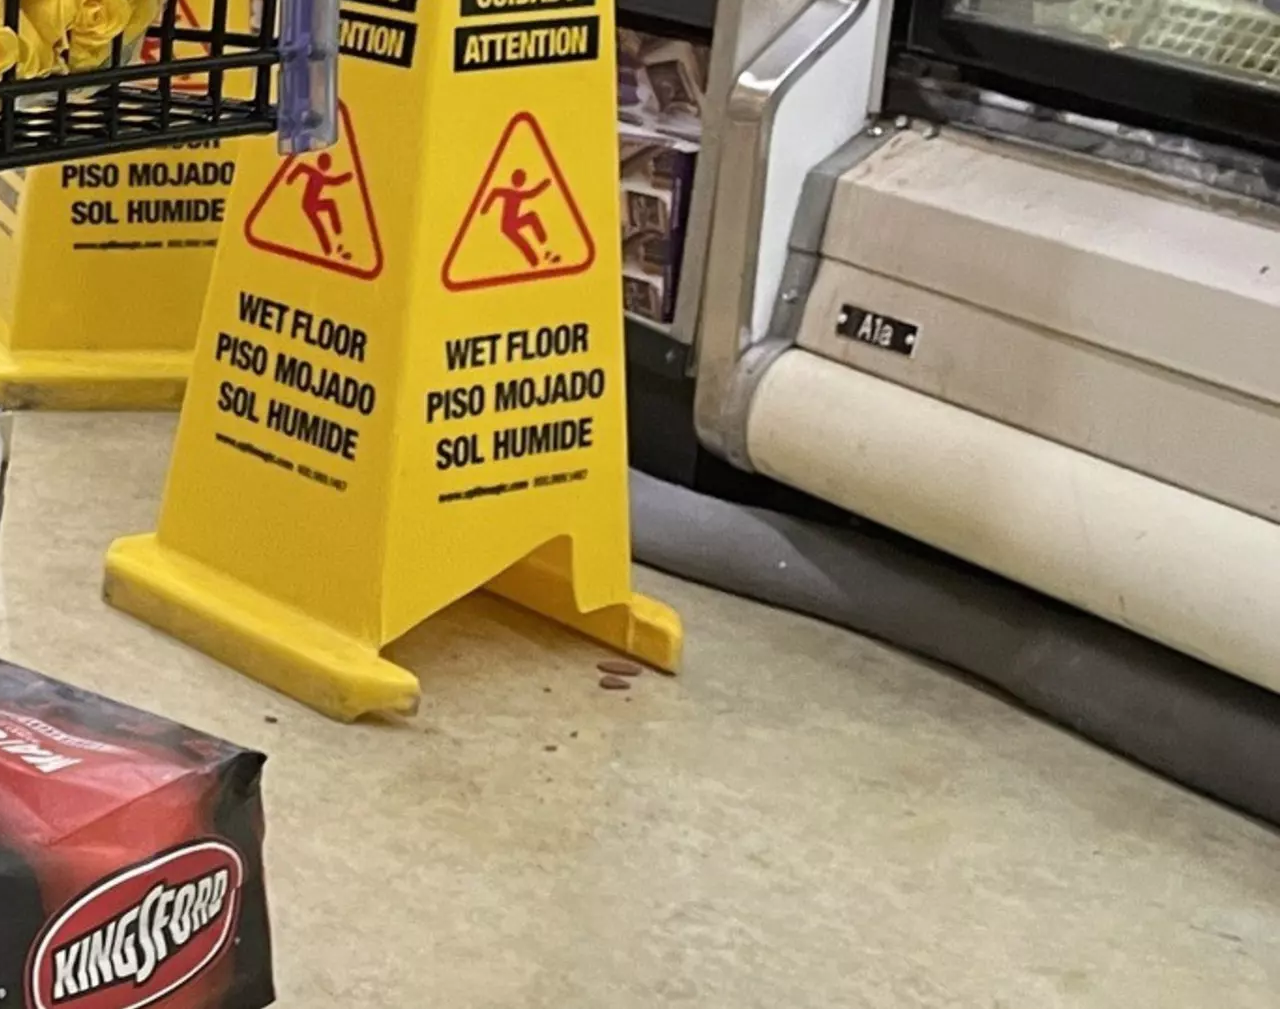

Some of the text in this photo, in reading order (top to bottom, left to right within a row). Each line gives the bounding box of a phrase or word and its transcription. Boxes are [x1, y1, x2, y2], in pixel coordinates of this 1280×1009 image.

[340, 20, 405, 59] NTION
[463, 25, 588, 65] ATTENTION
[61, 161, 235, 188] PISO MOJADO
[71, 198, 226, 225] SOL HUMIDE
[238, 291, 368, 363] WET FLOOR
[445, 322, 589, 371] WET FLOOR
[215, 332, 376, 416] PISO MOJADO
[426, 367, 605, 424] PISO MOJADO
[217, 381, 359, 462] SOL HUMIDE
[436, 417, 593, 471] SOL HUMIDE
[53, 869, 229, 997] KINGSFORD
